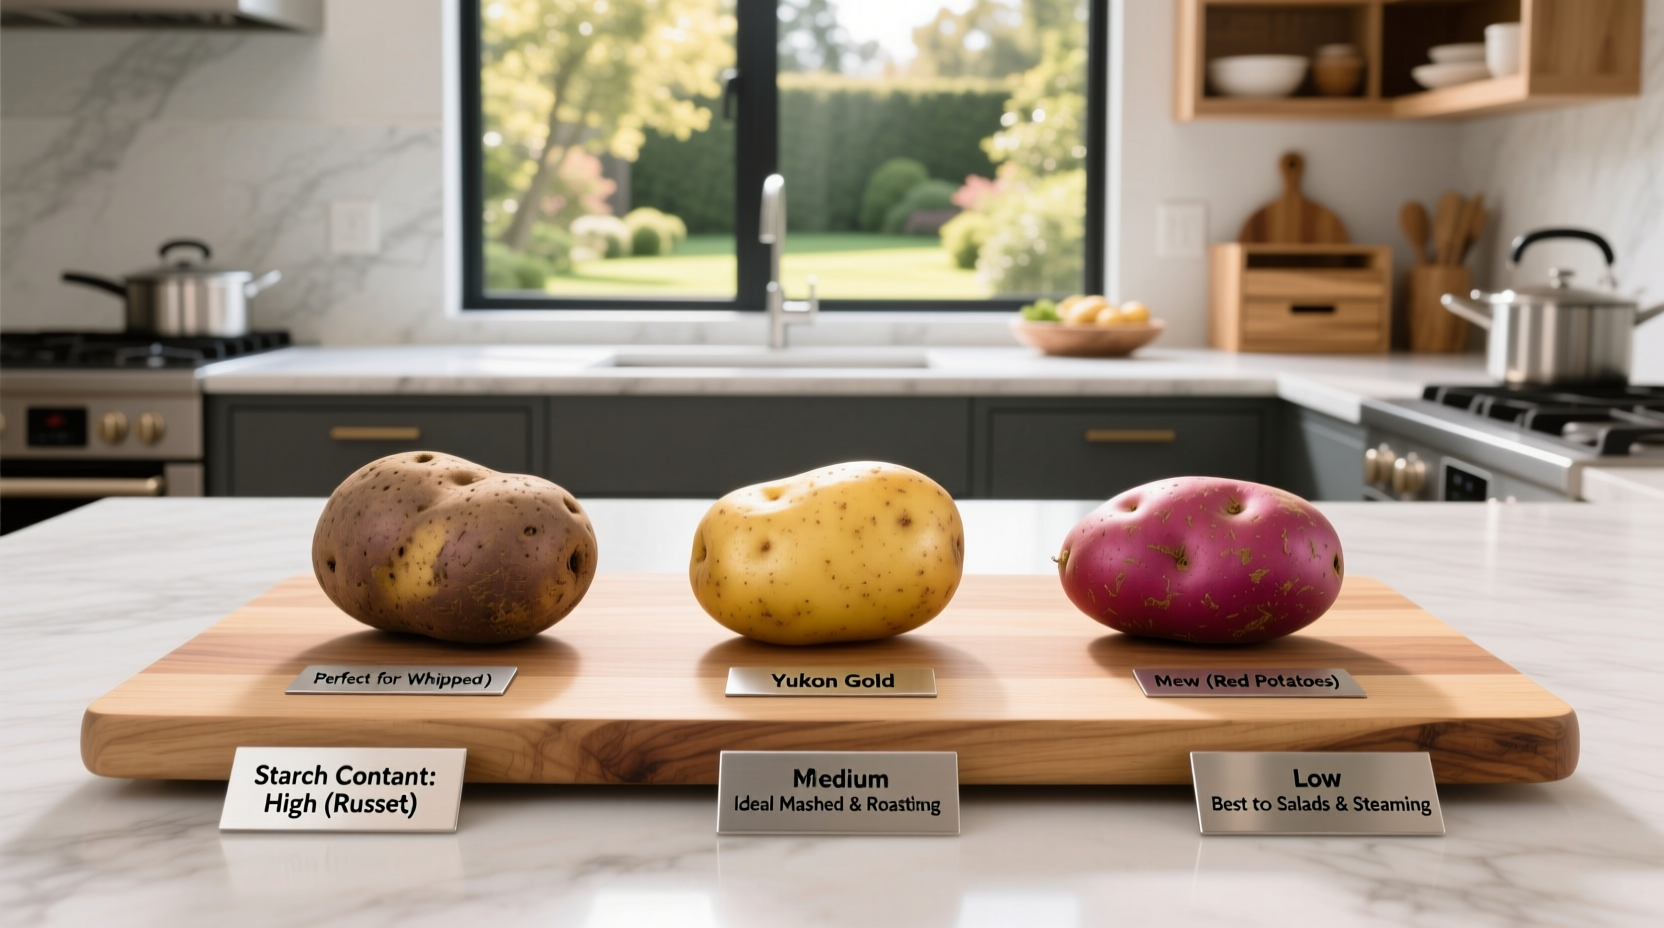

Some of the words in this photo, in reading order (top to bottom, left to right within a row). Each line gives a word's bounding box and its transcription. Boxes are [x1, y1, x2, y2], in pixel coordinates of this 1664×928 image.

[313, 671, 371, 685] Perfect
[377, 671, 402, 685] for
[407, 671, 492, 690] Whipped)
[771, 672, 838, 688] Yukon
[844, 673, 895, 688] Gold
[1154, 674, 1200, 688] Mew
[1206, 673, 1250, 690] (Red
[1254, 674, 1340, 690] Potatoes)
[254, 764, 328, 786] Starch
[335, 764, 436, 786] Contant:
[793, 767, 889, 789] Medium
[1293, 768, 1342, 788] Low
[264, 792, 317, 819] High
[324, 791, 417, 820] (Russet)
[734, 794, 774, 812] Ideal
[779, 795, 844, 812] Mashed
[849, 796, 862, 812] &
[1211, 795, 1248, 812] Best
[1252, 797, 1273, 812] to
[1276, 794, 1331, 812] Salads
[1335, 795, 1349, 812] &
[1352, 795, 1432, 817] Steaming
